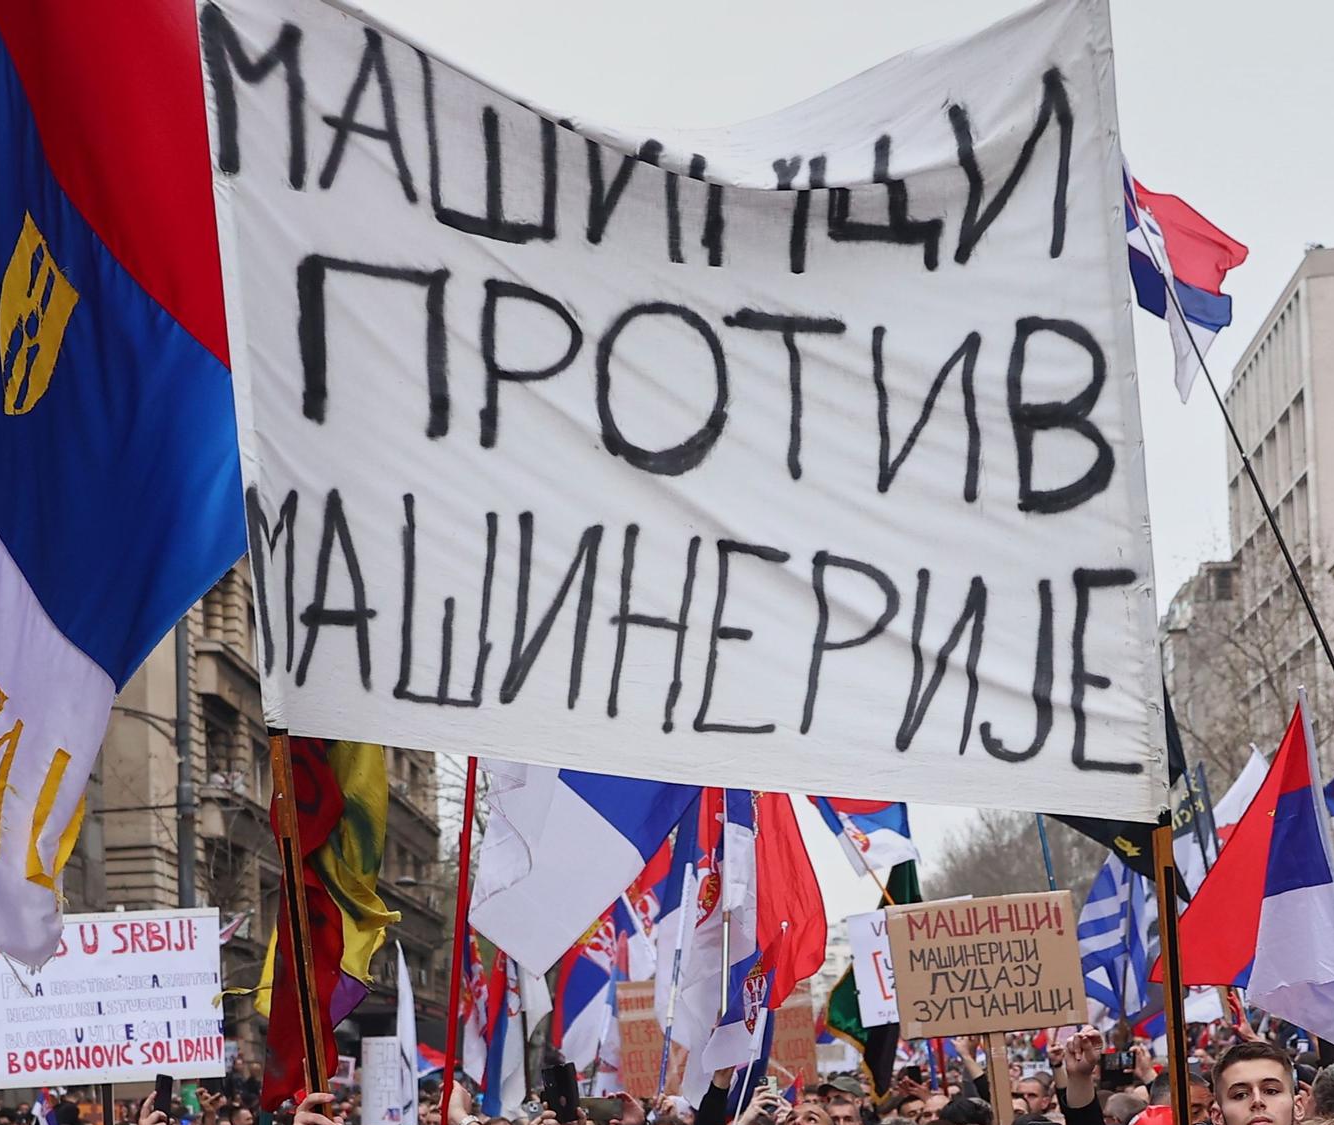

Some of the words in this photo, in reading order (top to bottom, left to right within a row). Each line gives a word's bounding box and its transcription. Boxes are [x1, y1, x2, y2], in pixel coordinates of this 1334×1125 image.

[297, 254, 1115, 513] ПРОТИВ
[246, 487, 1143, 774] МАШИНЕРИЈЕ
[78, 923, 99, 955] U
[111, 919, 198, 955] SRBIJI:
[907, 902, 1064, 941] МАШИНЦИ!
[909, 938, 1040, 972] МАШИНЕРИЈИ
[930, 963, 1042, 995] ПУЦАЈУ
[913, 988, 1075, 1022] ЗУПЧАНИЦИ
[7, 1041, 133, 1075] BOGDANOVIĆ
[140, 1036, 224, 1065] SOLIDAN!
